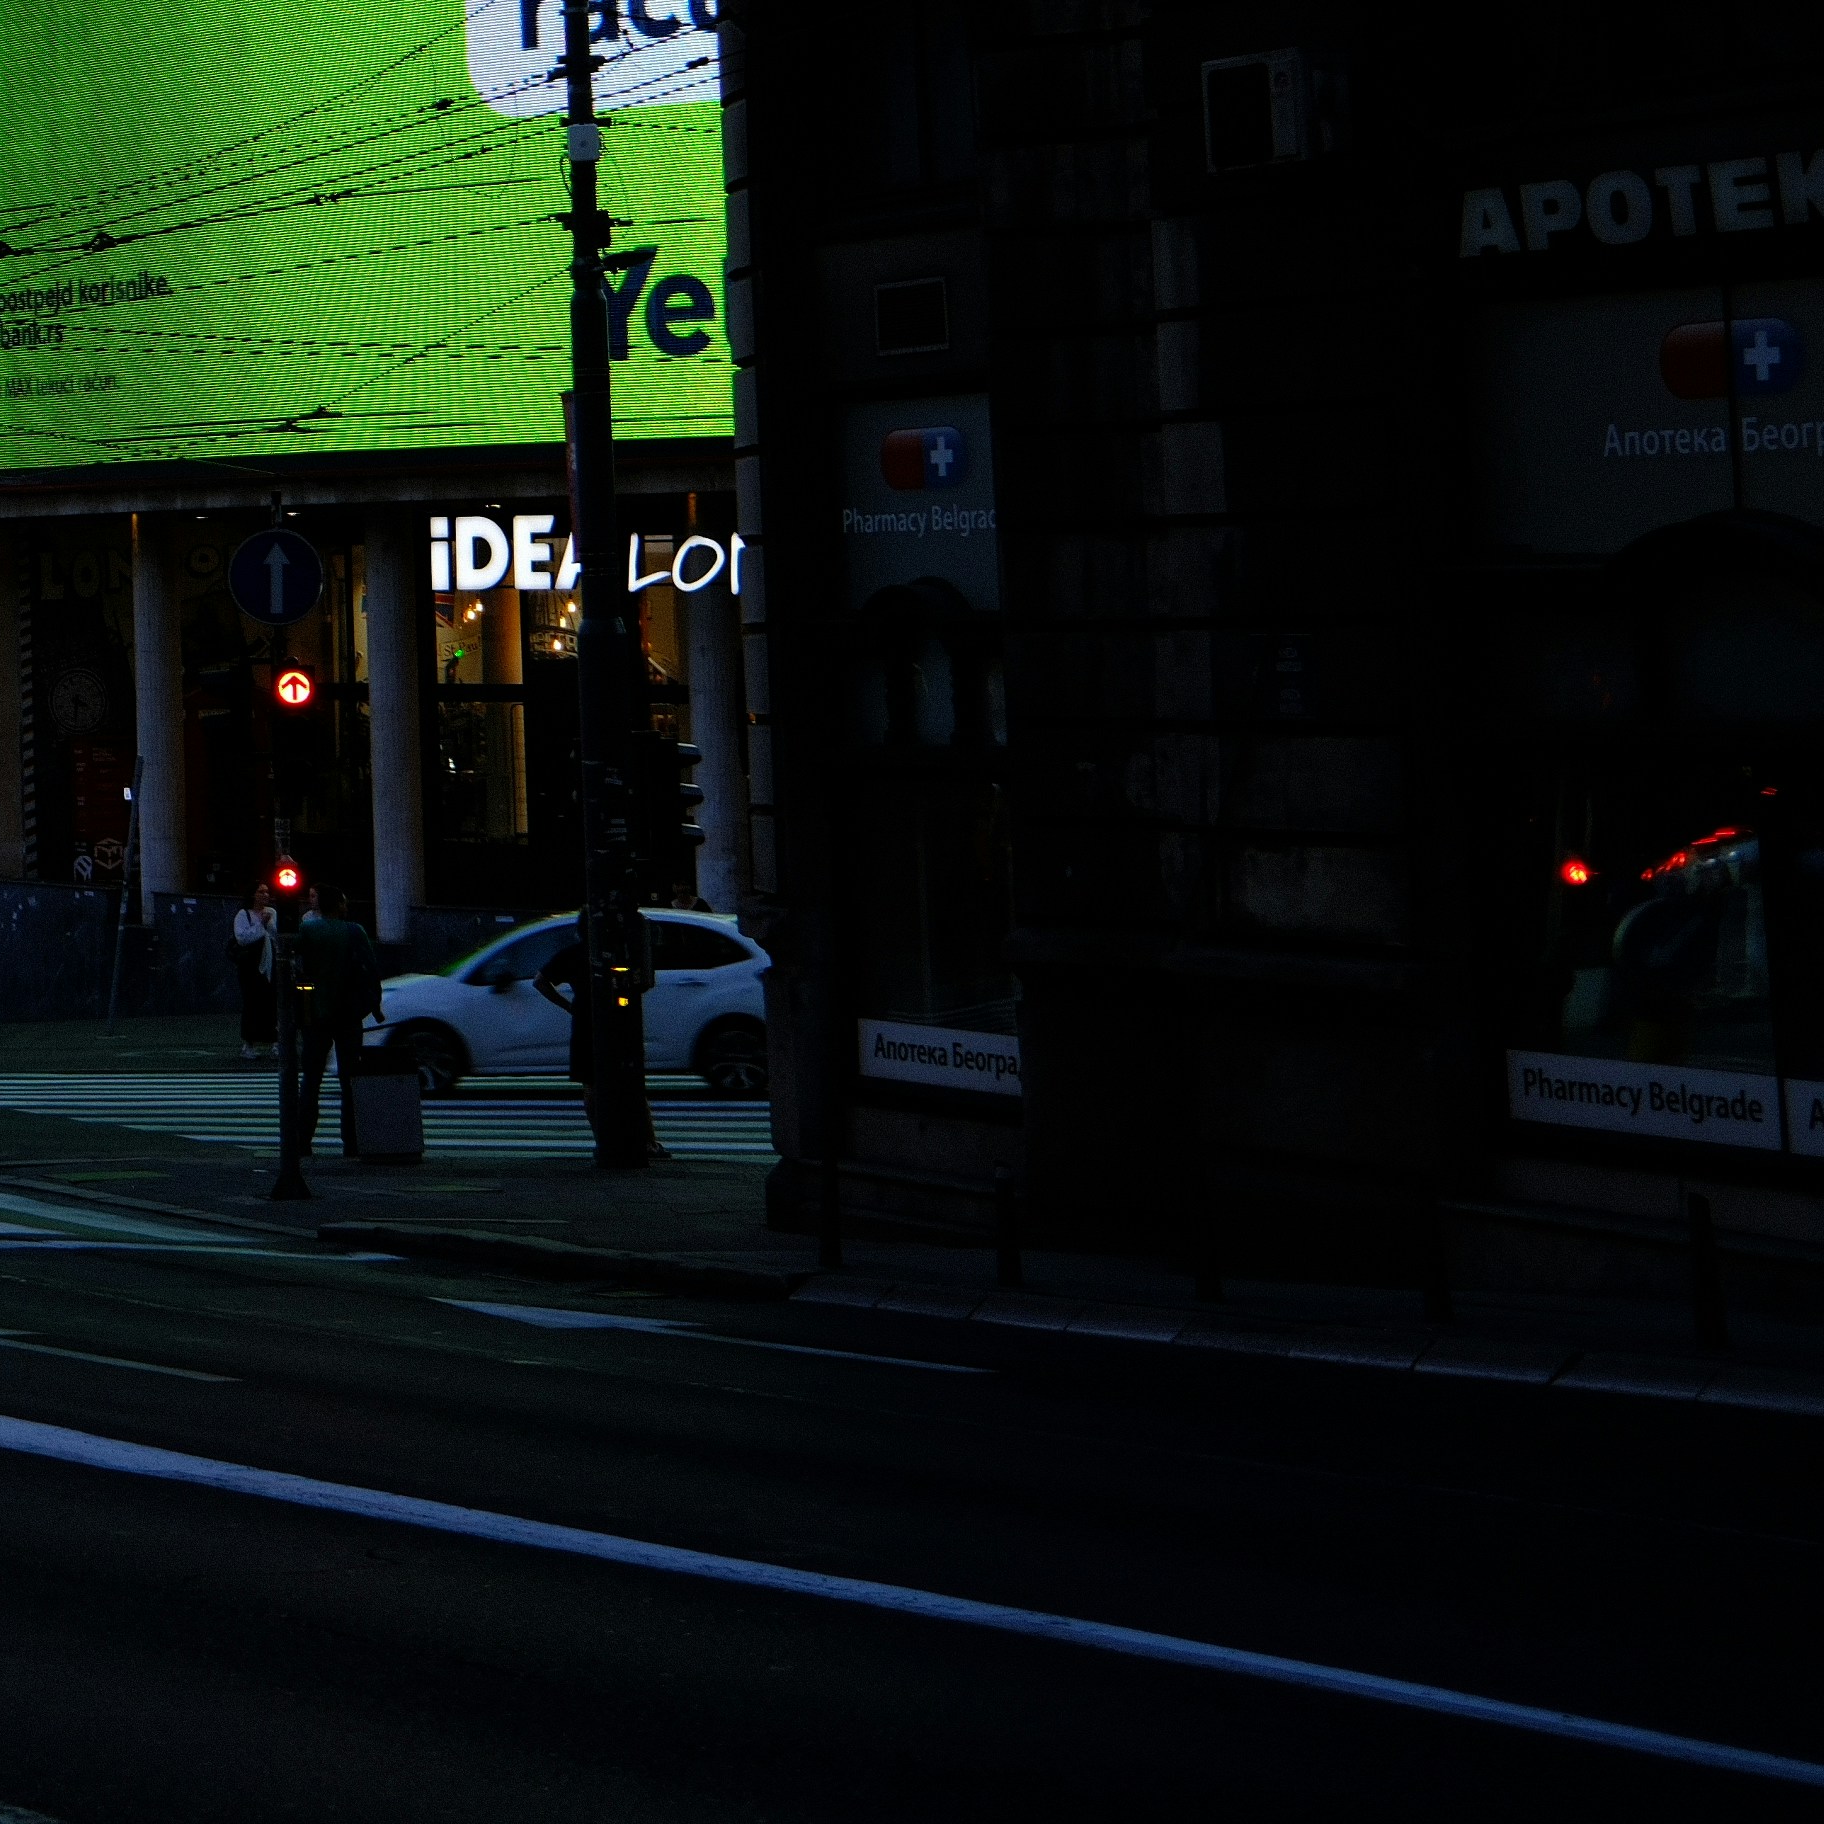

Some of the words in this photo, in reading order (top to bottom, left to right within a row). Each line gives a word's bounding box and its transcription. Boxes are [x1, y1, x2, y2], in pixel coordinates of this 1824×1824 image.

[1603, 422, 1728, 458] Апотека
[842, 507, 927, 538] Pharmacy
[874, 1033, 949, 1066] Апотека
[952, 1042, 1022, 1080] Београ
[1522, 1067, 1643, 1116] Pharmacy
[1649, 1081, 1764, 1123] Belgrade
